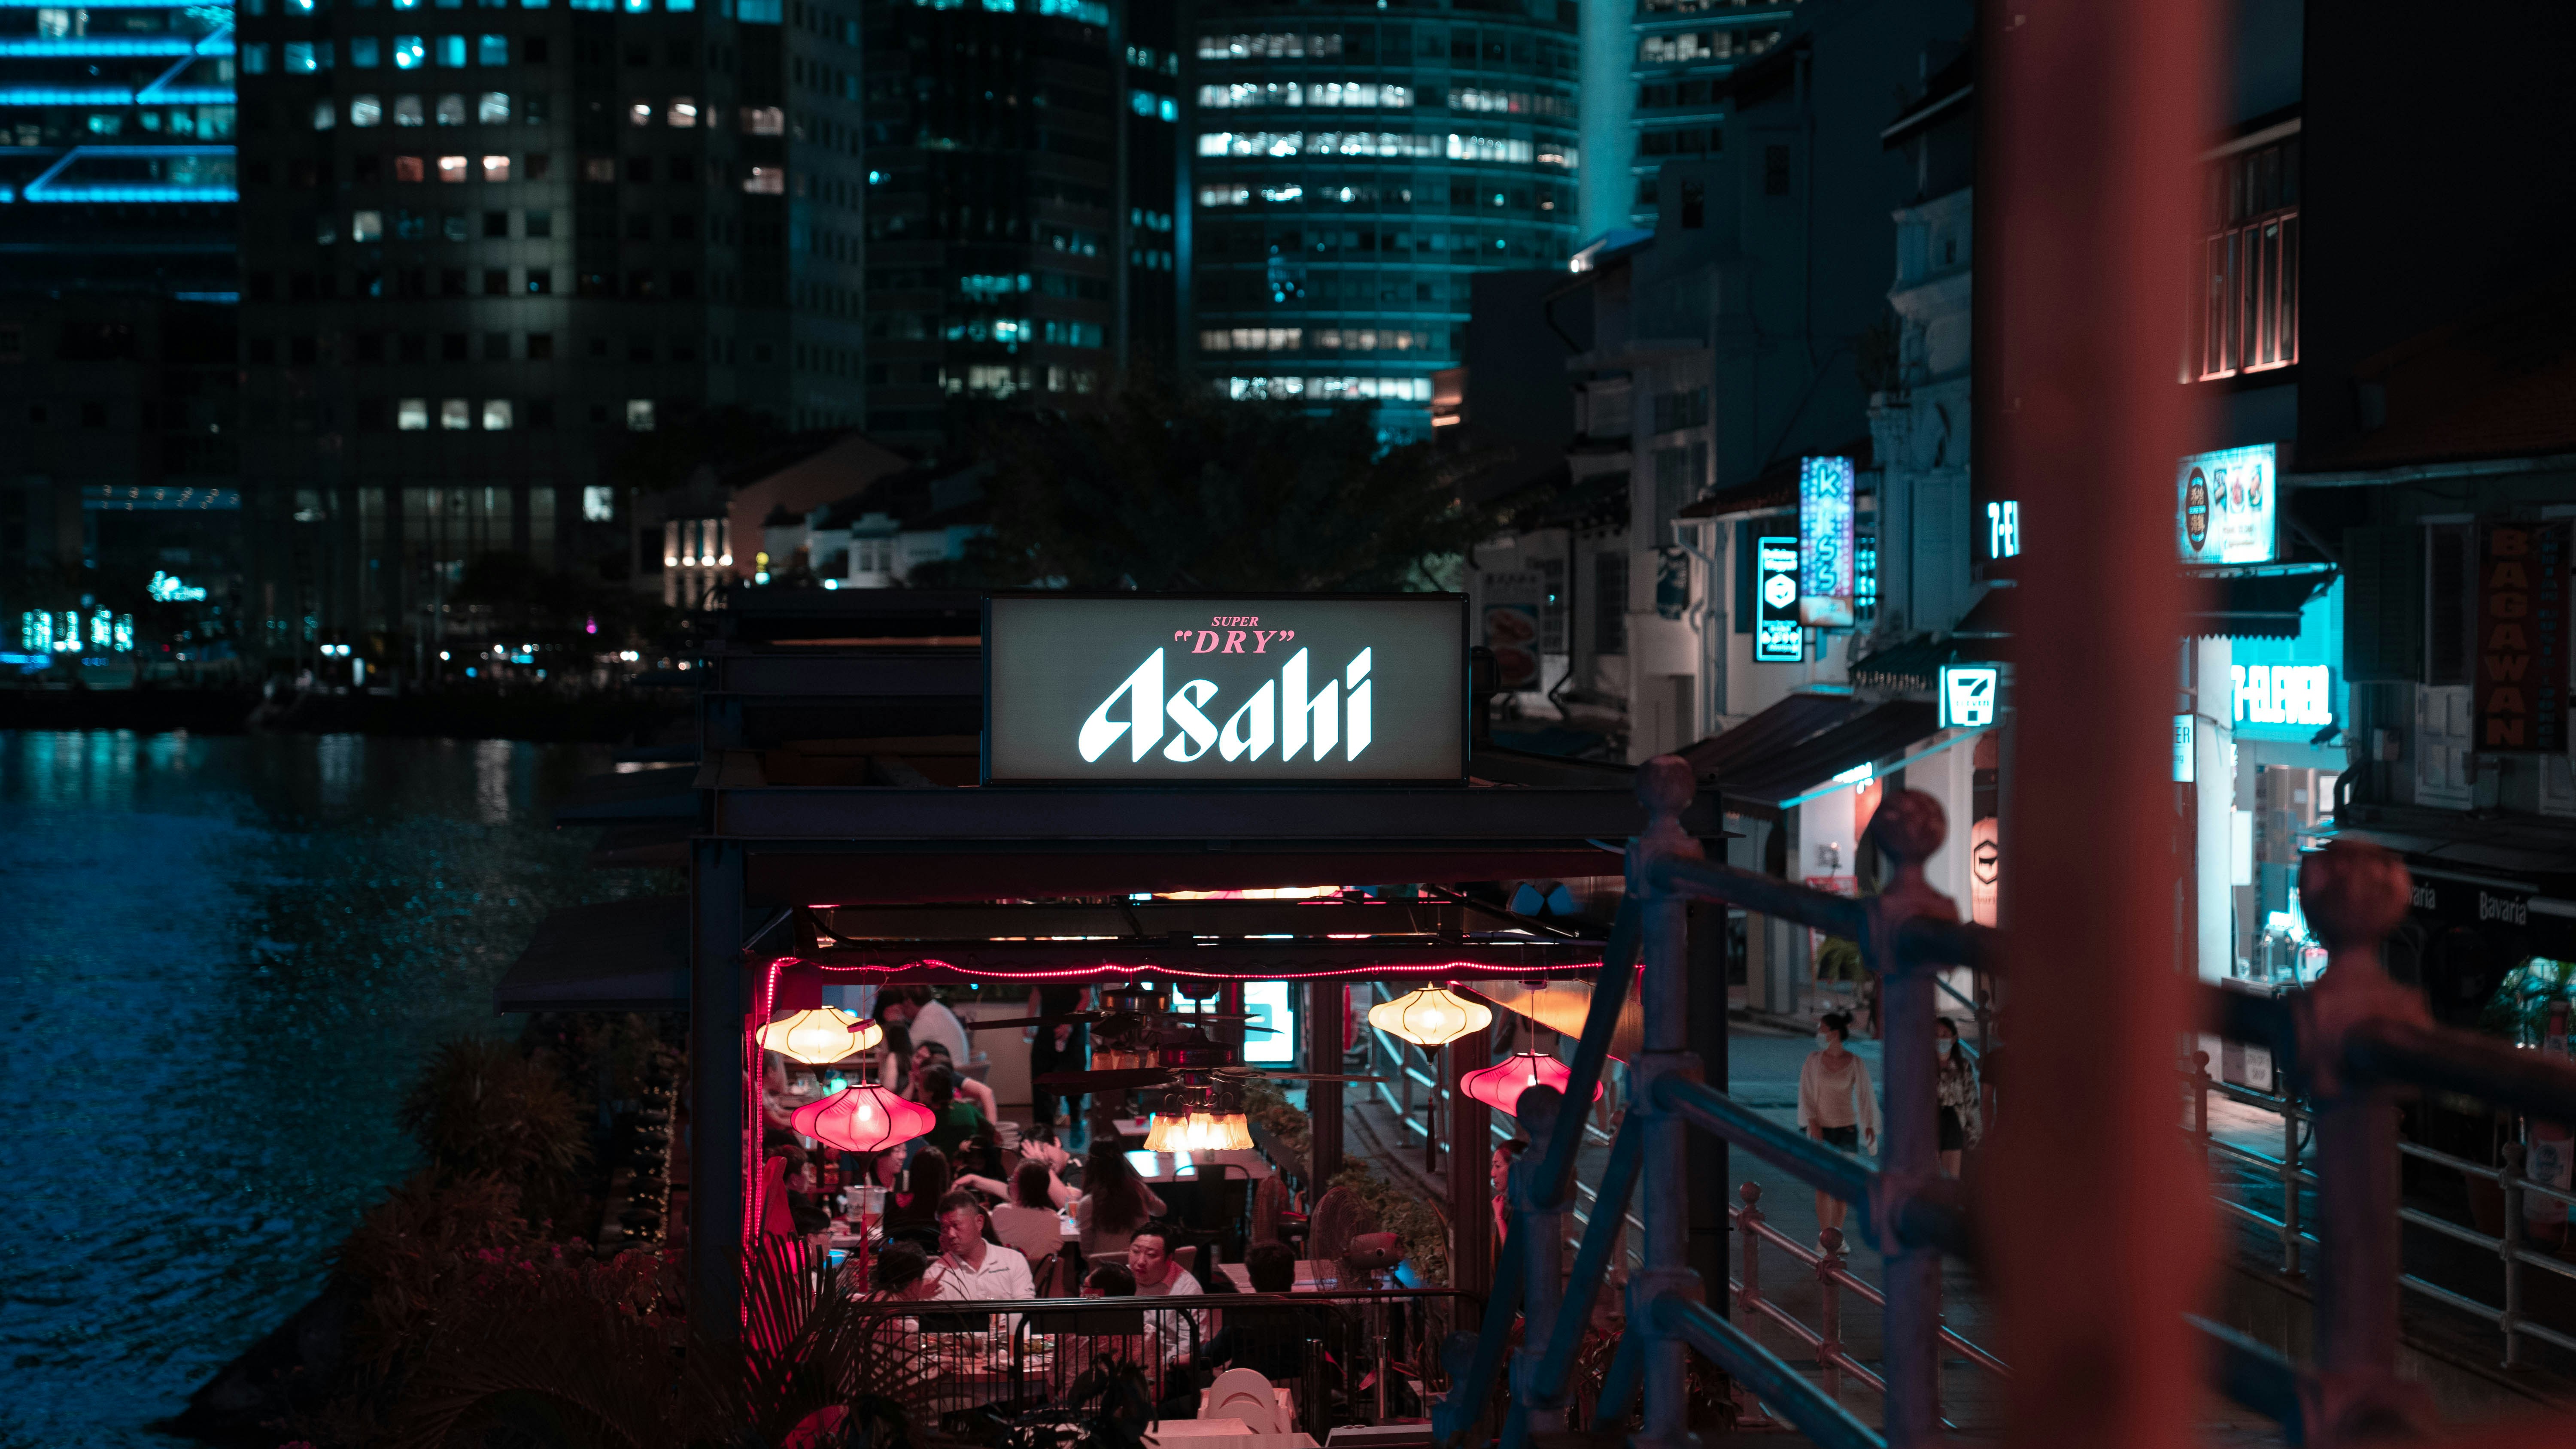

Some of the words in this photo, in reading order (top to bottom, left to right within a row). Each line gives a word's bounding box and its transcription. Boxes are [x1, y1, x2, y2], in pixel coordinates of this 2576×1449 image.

[1211, 616, 1259, 627] SUPER
[1958, 678, 1988, 697] 7
[1078, 646, 1371, 763] Asahi
[2174, 727, 2190, 743] ER
[2479, 891, 2527, 925] Bavaria
